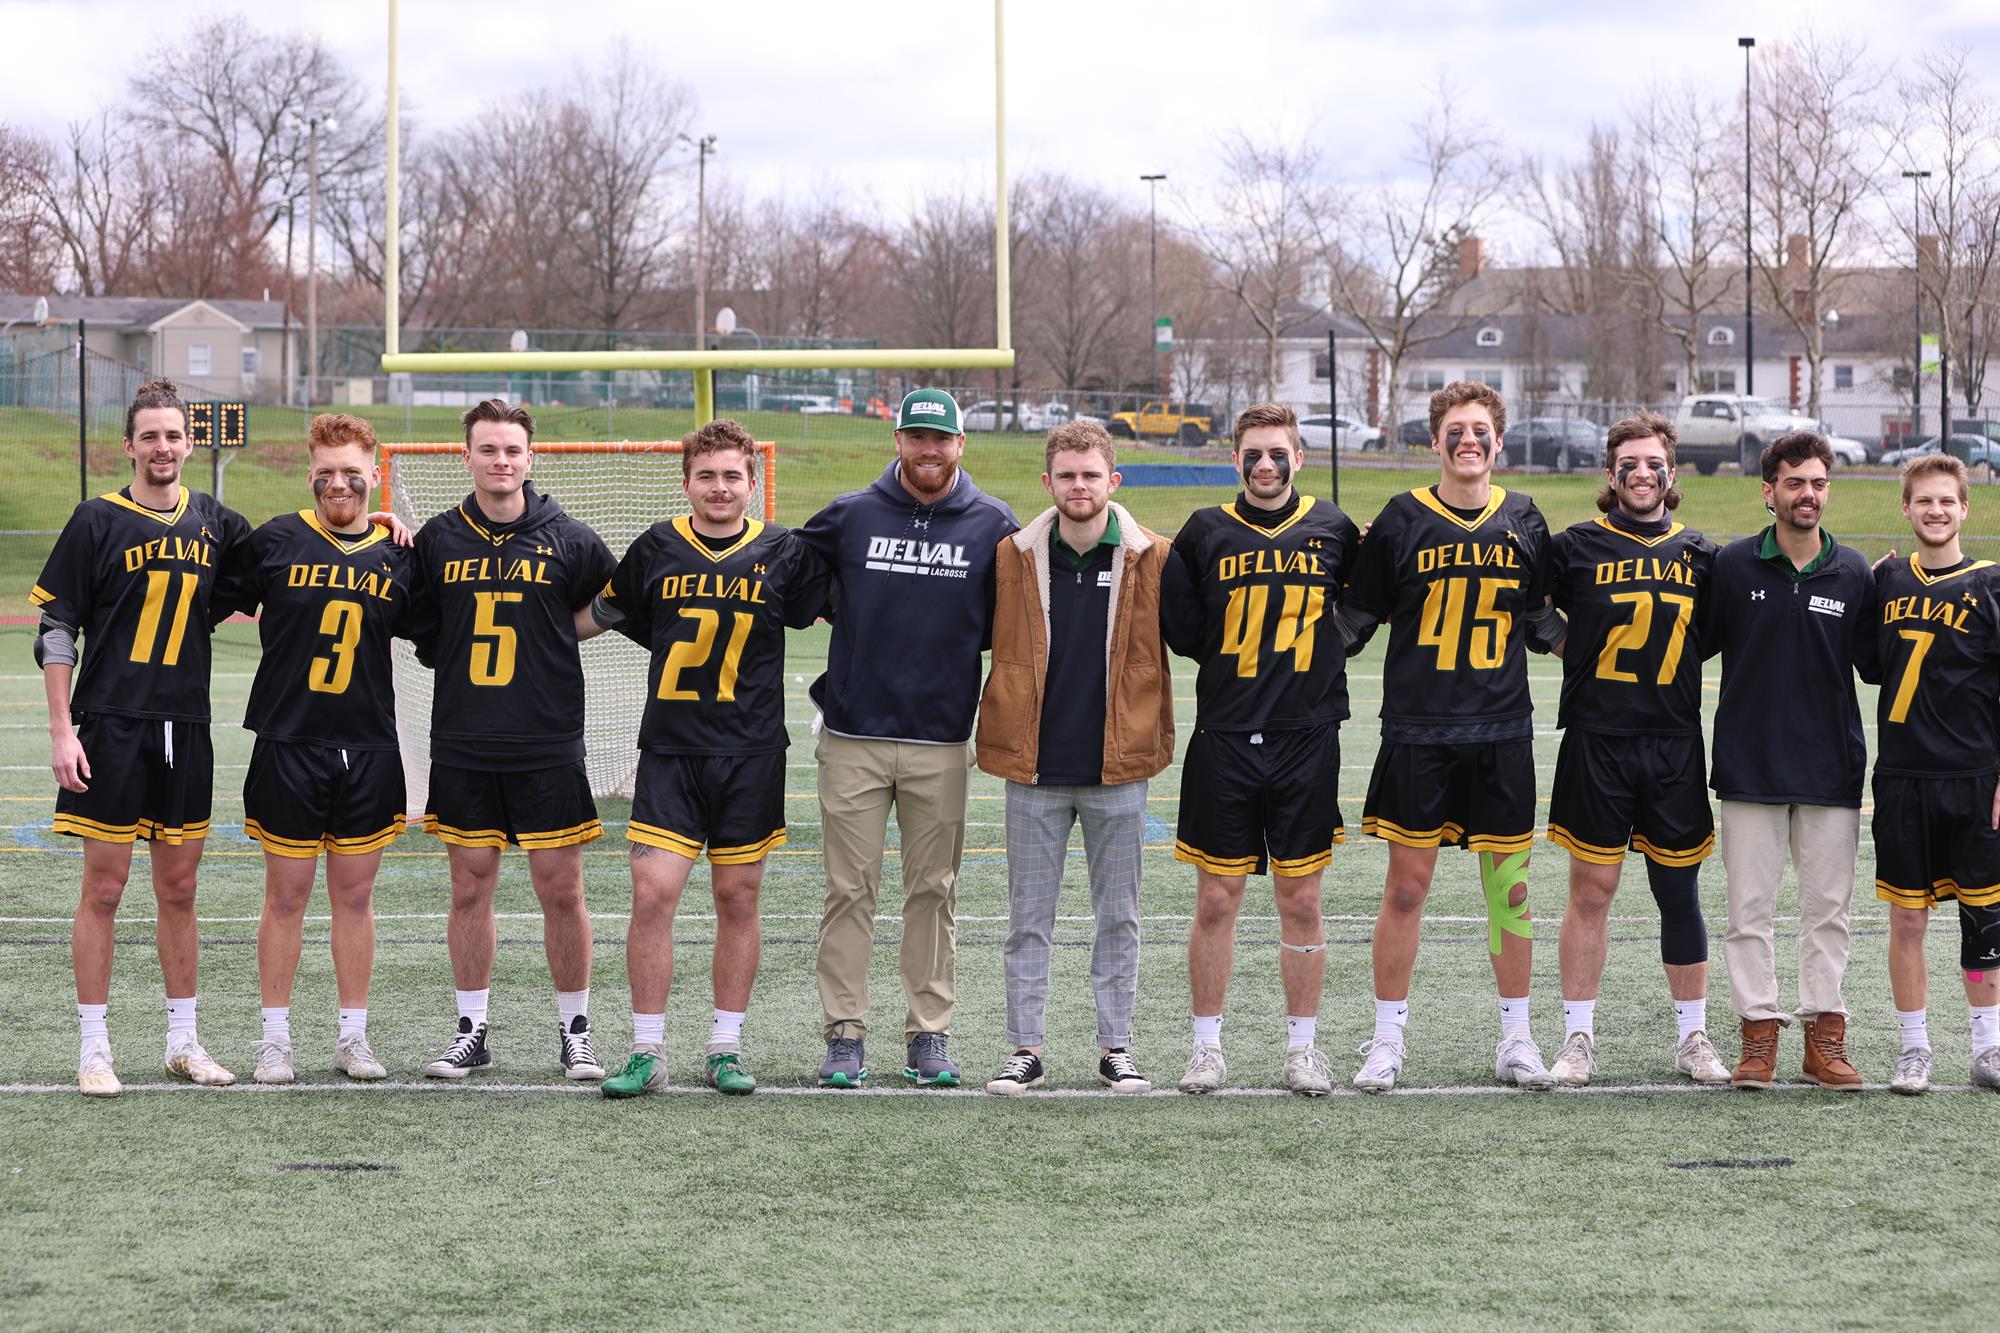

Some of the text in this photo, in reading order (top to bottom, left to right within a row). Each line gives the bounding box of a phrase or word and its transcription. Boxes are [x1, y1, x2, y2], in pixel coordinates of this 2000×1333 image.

[910, 402, 946, 413] DELVAL
[125, 537, 211, 572] DELVAL
[866, 536, 972, 567] DELVAL
[1219, 550, 1326, 581] DELVAL
[1417, 543, 1521, 573] DELVAL
[288, 564, 393, 601] DELVAL
[444, 558, 553, 584] DELVAL
[662, 573, 767, 604] DELVAL
[930, 567, 968, 579] LACROSSE
[1595, 558, 1696, 587] DELVAL
[129, 570, 198, 665] 11
[1809, 595, 1845, 613] DELVAL
[1884, 596, 1970, 634] DELVAL
[469, 591, 523, 686] 5
[1220, 585, 1326, 678] 44
[1417, 578, 1520, 670] 45
[1595, 591, 1694, 684] 27
[308, 600, 363, 694] 3
[657, 608, 755, 702] 21
[1888, 629, 1935, 724] 7
